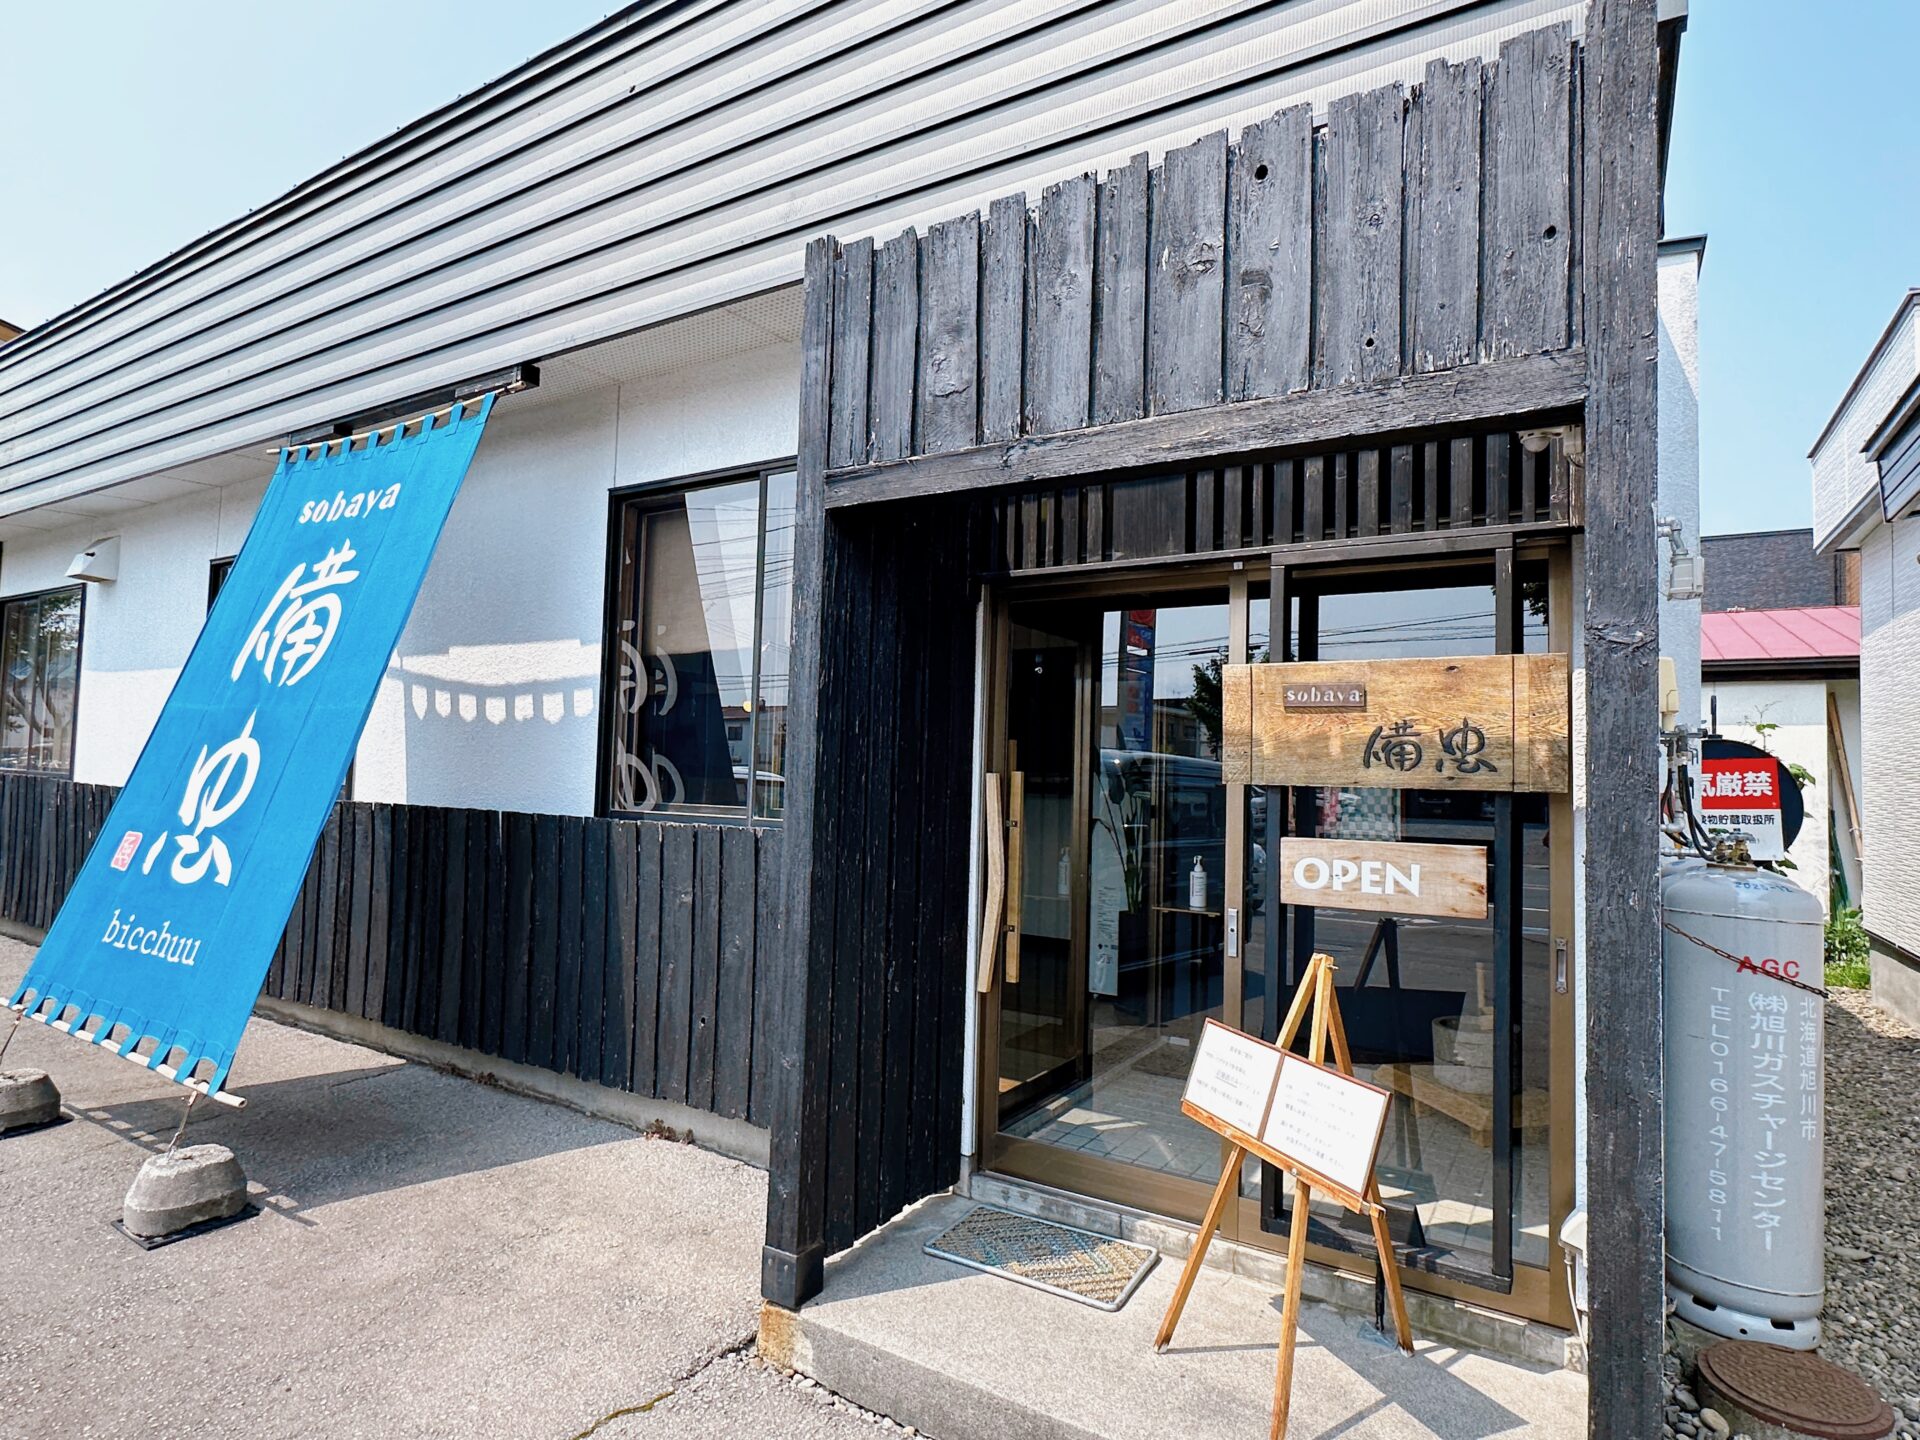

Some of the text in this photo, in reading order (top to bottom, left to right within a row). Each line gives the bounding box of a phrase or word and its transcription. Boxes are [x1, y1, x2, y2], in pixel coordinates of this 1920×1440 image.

[298, 482, 401, 524] sobaya
[1286, 687, 1361, 702] sobaya
[1293, 857, 1421, 897] OPEN
[102, 909, 202, 966] bicchuu
[1736, 956, 1801, 979] AGC
[1800, 997, 1817, 1141] 北海道旭川市
